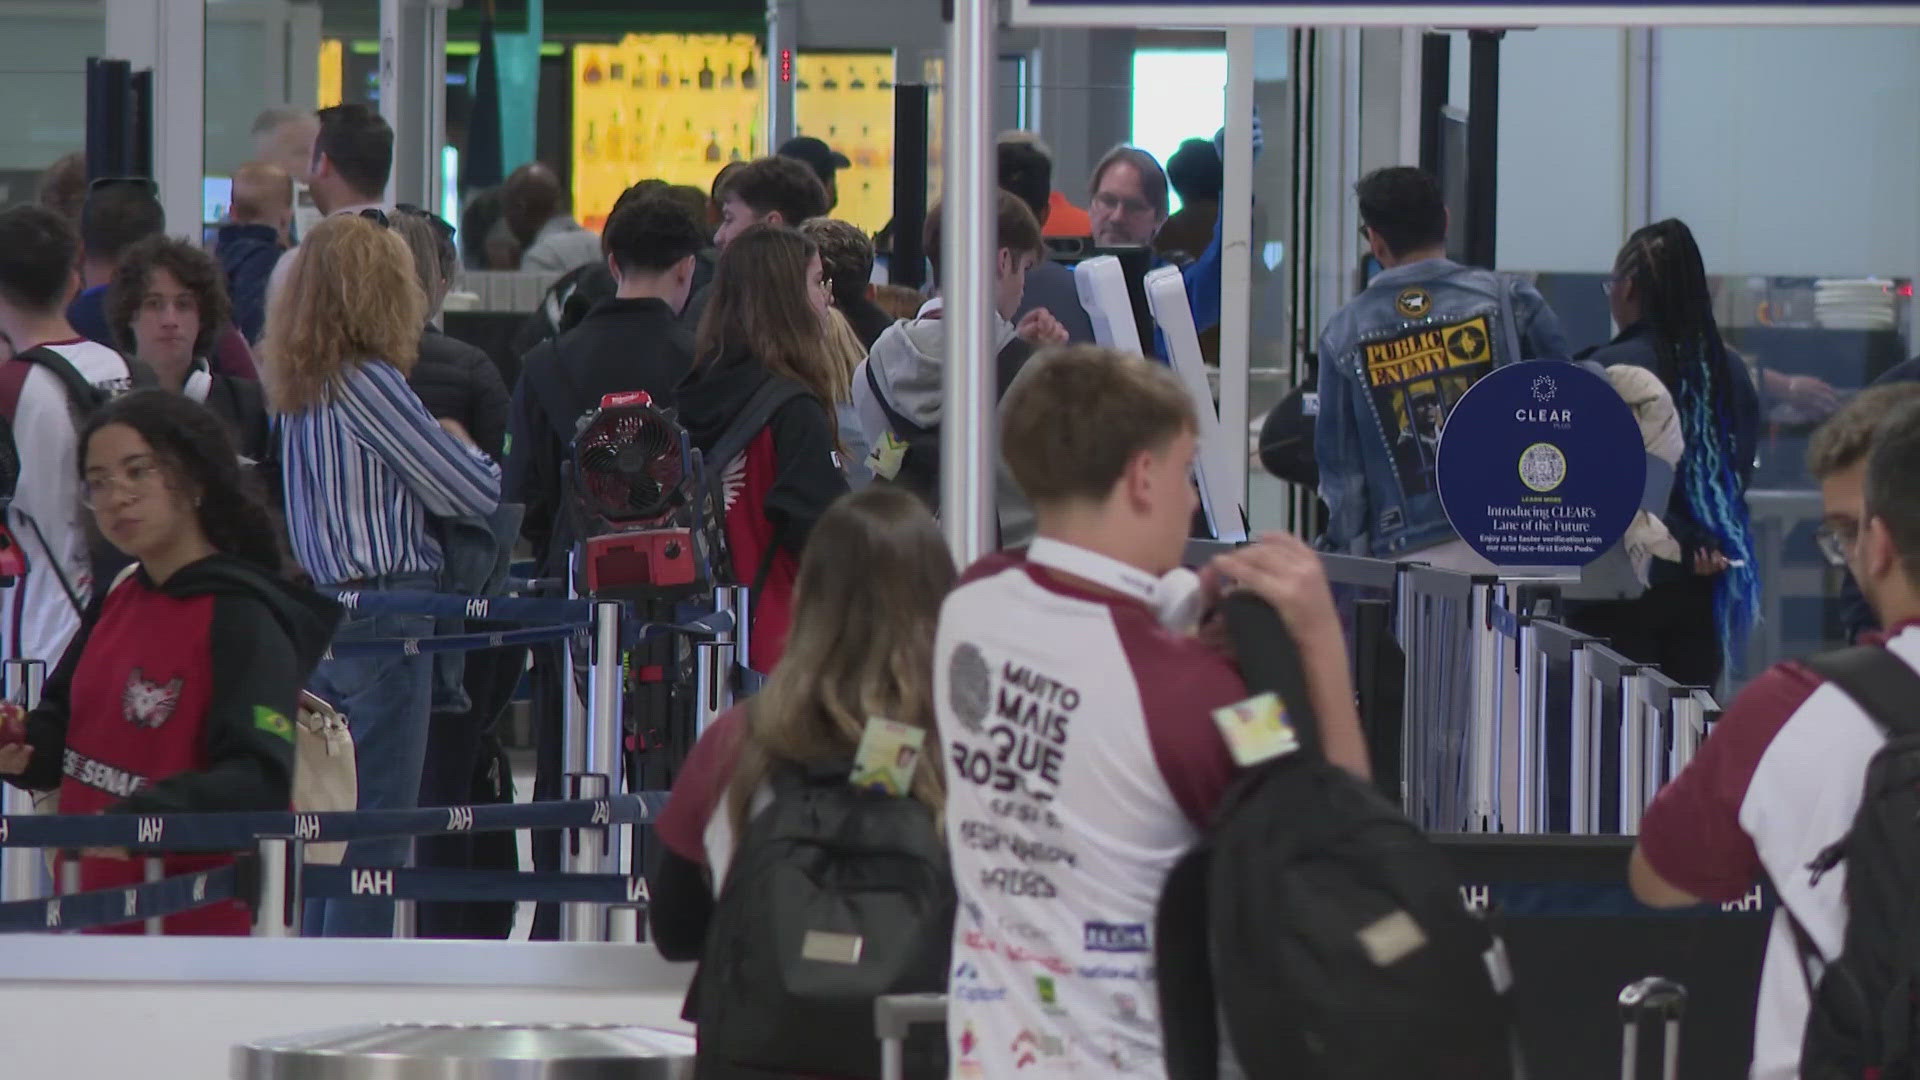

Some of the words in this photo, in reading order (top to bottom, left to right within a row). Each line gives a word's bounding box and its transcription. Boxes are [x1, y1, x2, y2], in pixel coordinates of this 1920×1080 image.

[1366, 331, 1442, 363] PUBLIC
[1369, 352, 1446, 387] ENEMY
[1515, 408, 1572, 423] CLEAR
[1487, 505, 1550, 520] Introducing
[1551, 505, 1596, 519] CLEAR's
[1493, 519, 1519, 531] Lane
[1521, 519, 1534, 531] of
[1534, 519, 1553, 532] the
[1554, 520, 1590, 533] Future
[1480, 535, 1500, 544] Enjoy
[1518, 535, 1541, 543] faster
[1542, 535, 1584, 544] verification
[1585, 536, 1602, 544] with
[1518, 544, 1553, 552] face-first
[1003, 660, 1081, 711] MUITO
[997, 686, 1069, 745] MAIS
[989, 724, 1064, 786] QUE
[138, 816, 164, 842] IAH
[294, 815, 320, 839] IAH
[447, 806, 474, 831] IAH
[351, 868, 393, 896] IAH
[626, 876, 651, 902] IA
[1459, 885, 1489, 911] AH
